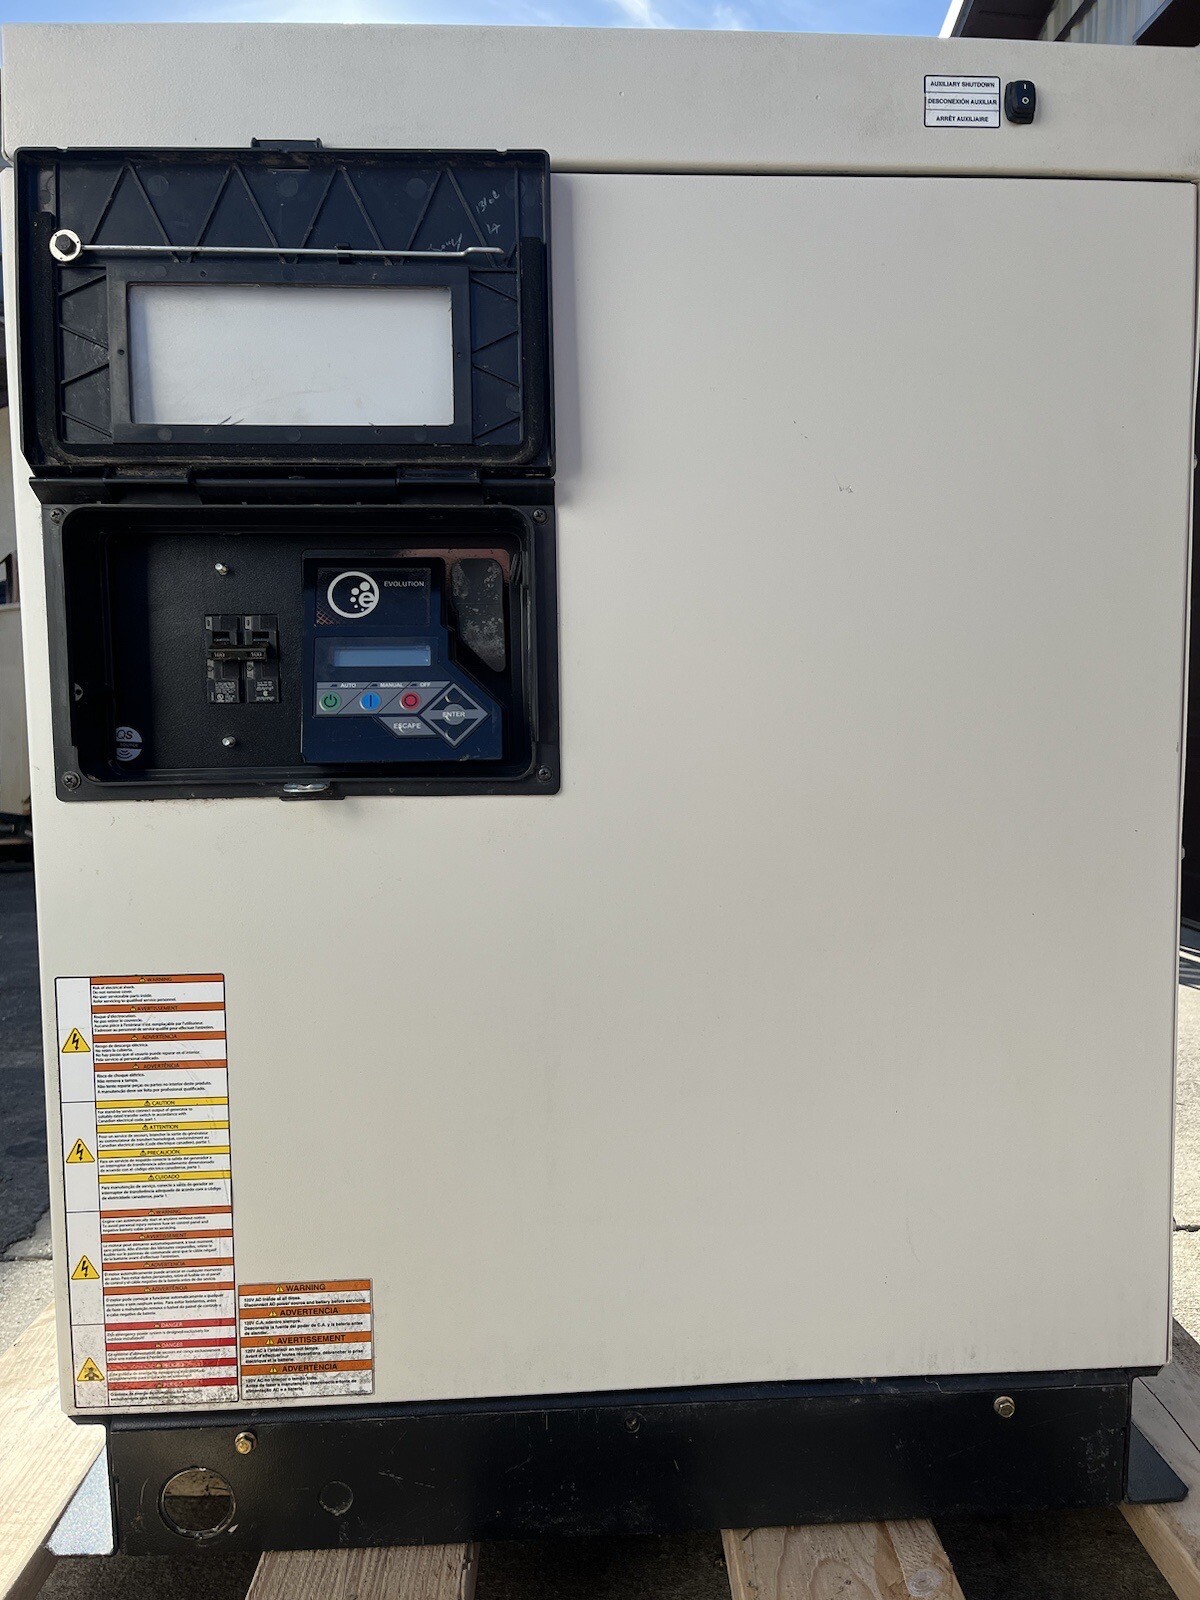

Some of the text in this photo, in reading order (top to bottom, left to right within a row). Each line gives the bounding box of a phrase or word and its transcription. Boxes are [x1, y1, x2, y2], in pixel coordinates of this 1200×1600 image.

[286, 1283, 326, 1292] WARNING
[280, 1306, 339, 1316] ADVERTENCIA
[277, 1334, 346, 1344] AVERTISSEMENT
